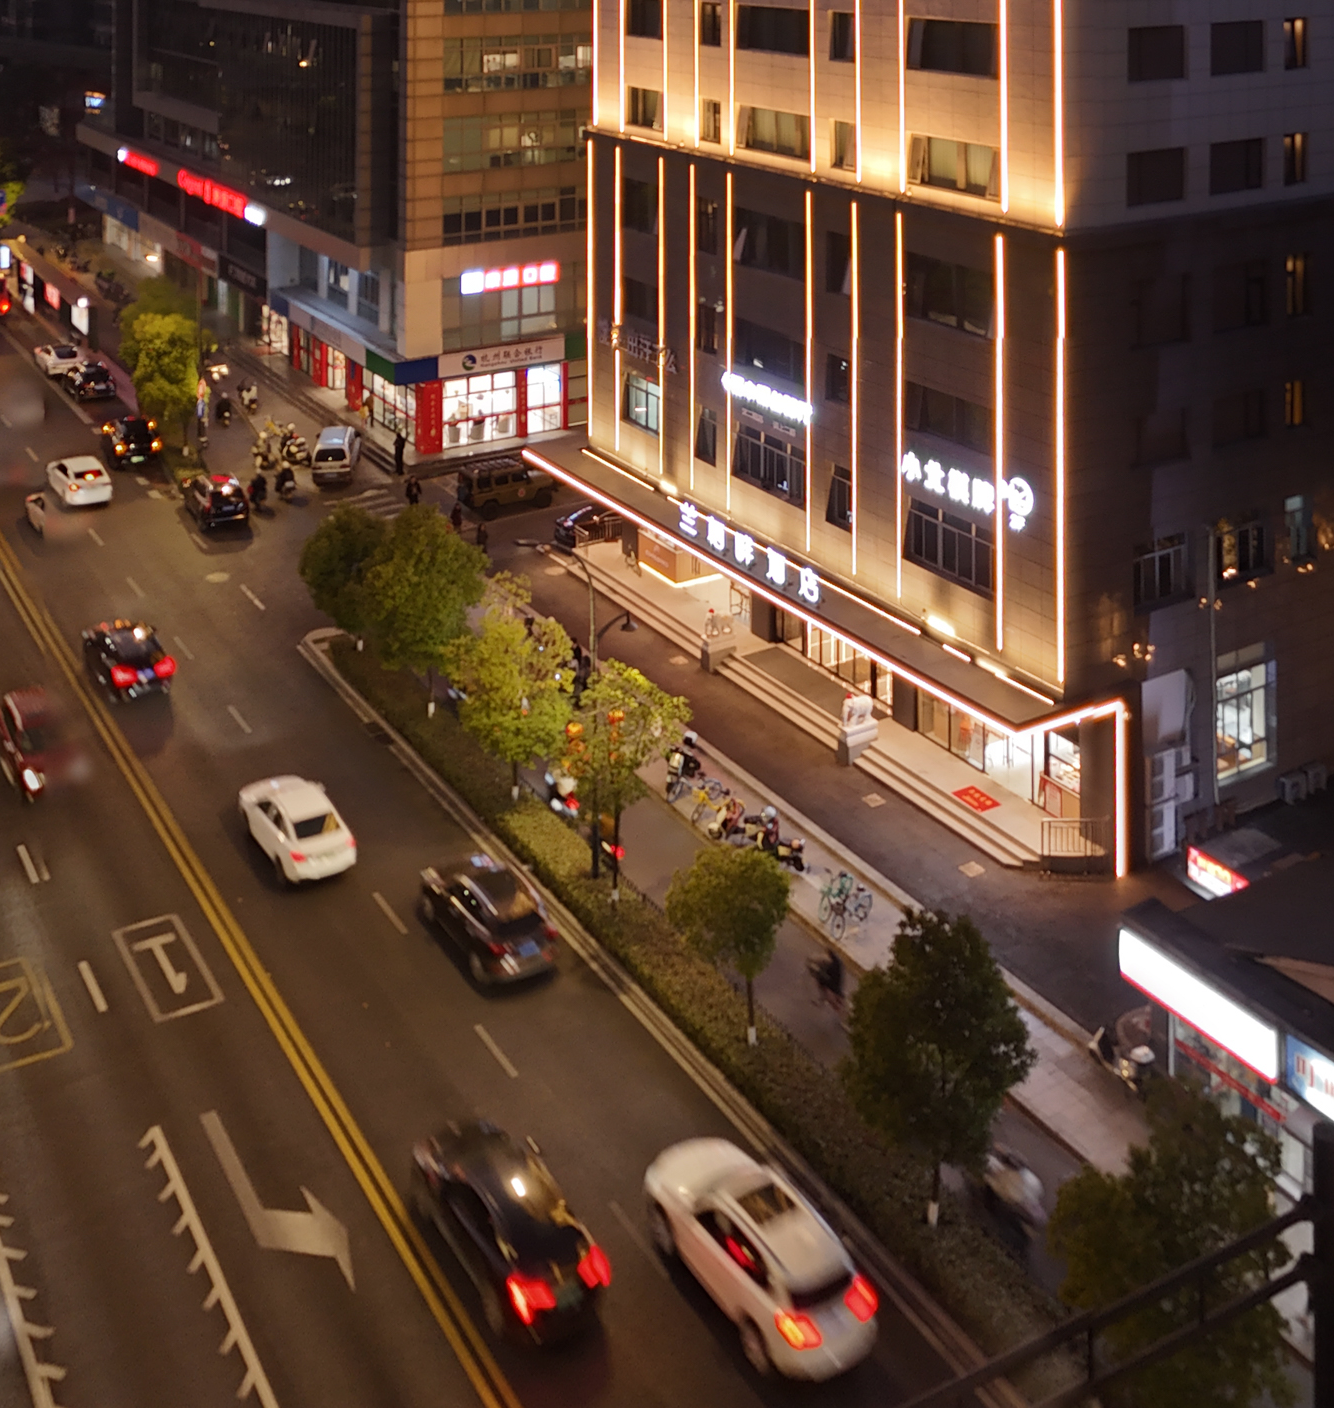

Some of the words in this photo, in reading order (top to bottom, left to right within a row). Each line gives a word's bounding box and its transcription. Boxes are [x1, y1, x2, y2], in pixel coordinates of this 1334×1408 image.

[480, 345, 543, 363] 杭州联合银行
